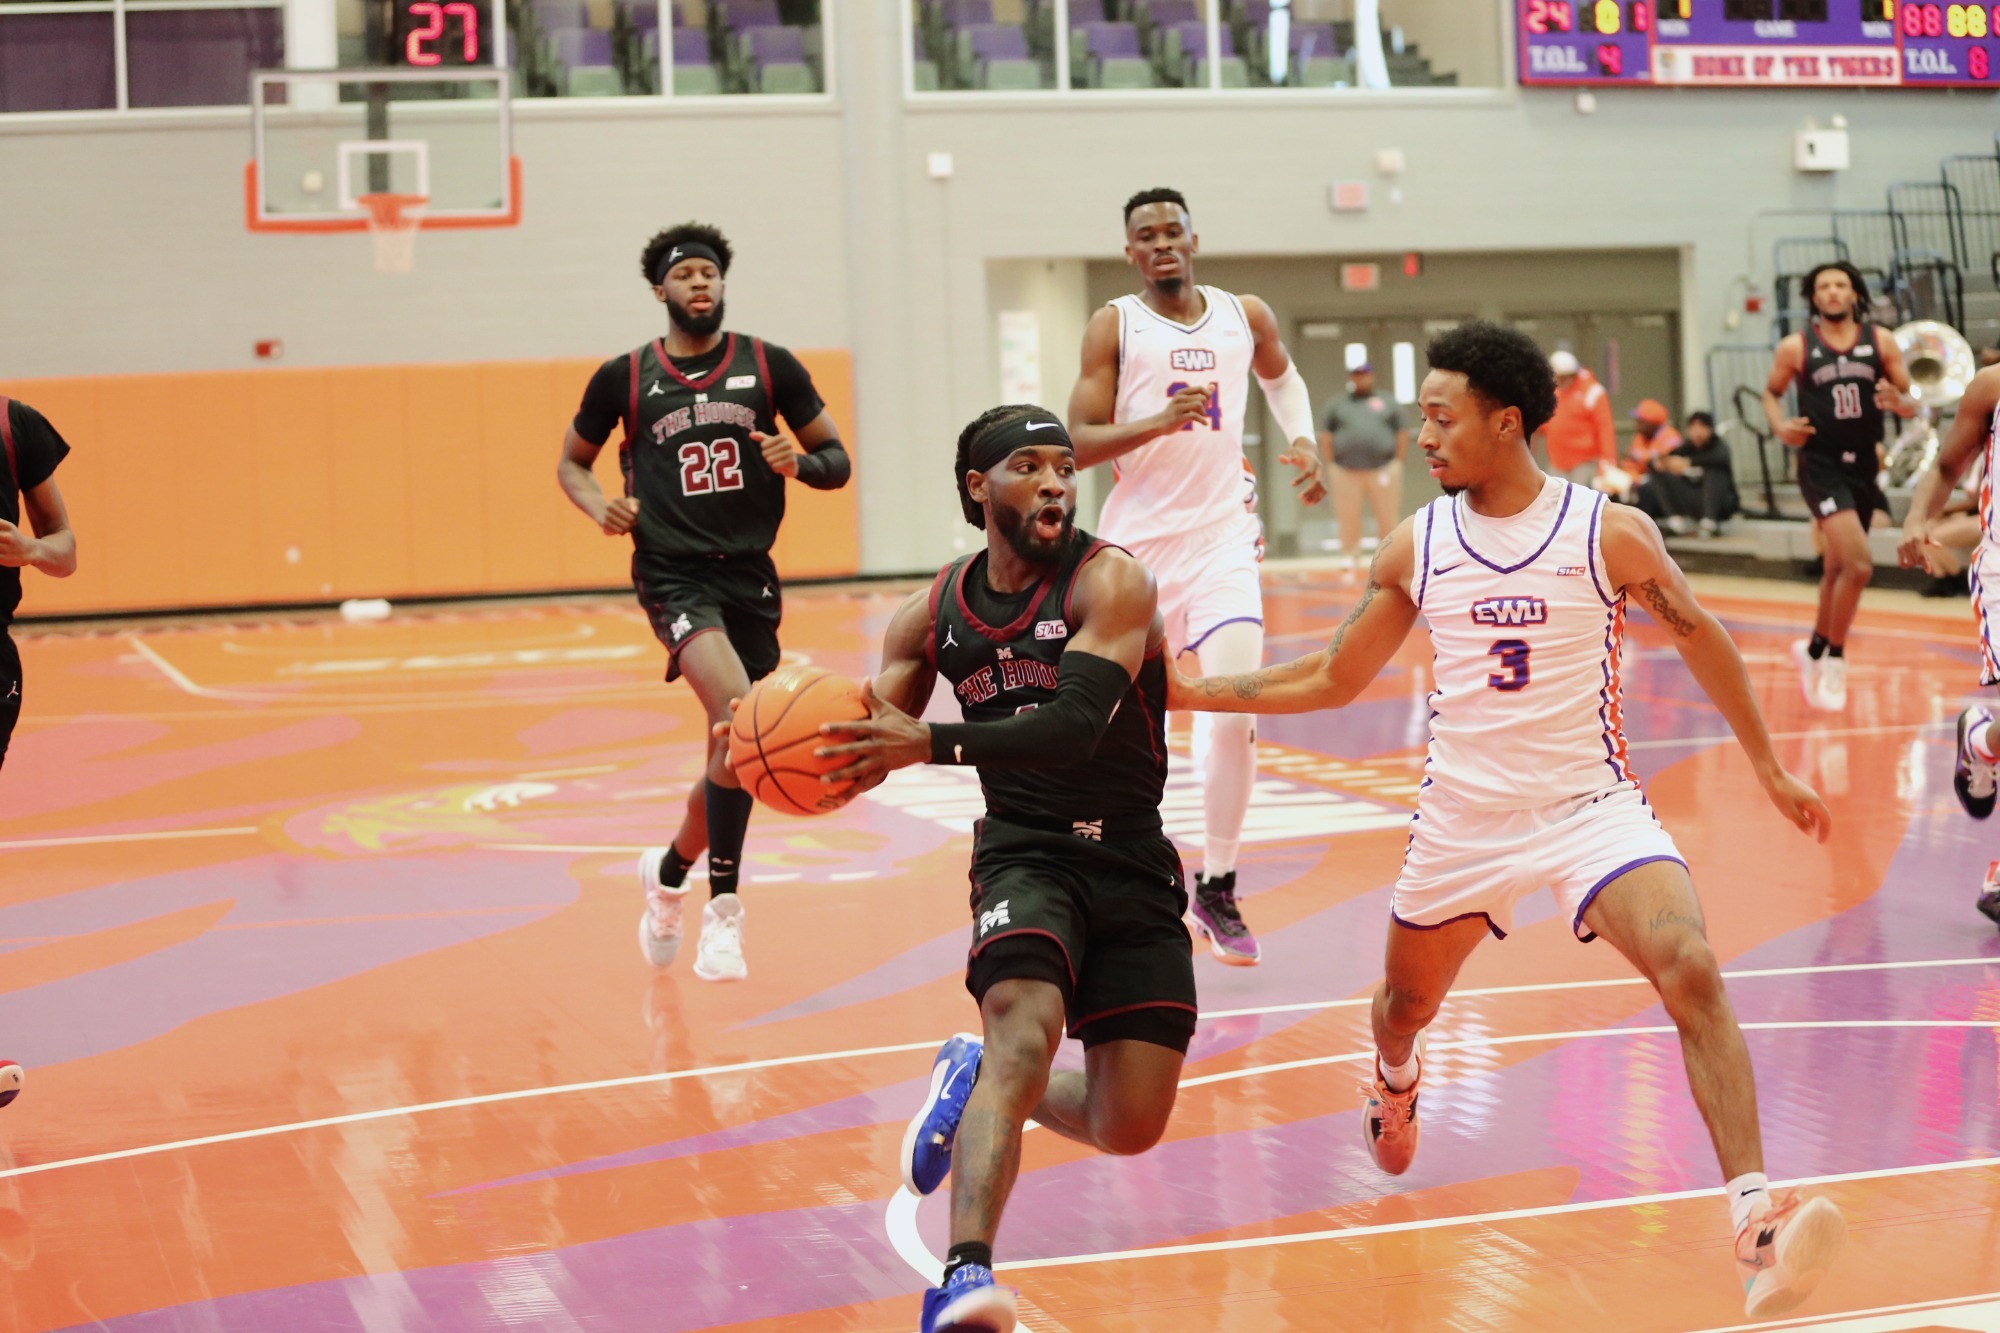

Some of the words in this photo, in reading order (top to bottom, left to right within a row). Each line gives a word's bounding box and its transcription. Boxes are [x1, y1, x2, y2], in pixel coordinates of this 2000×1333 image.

[406, 2, 478, 66] 27
[1525, 0, 1572, 34] 24
[1902, 3, 1943, 37] 88
[1946, 4, 1987, 38] 88
[1597, 44, 1622, 75] 4
[1968, 46, 1989, 79] 8
[1172, 350, 1215, 371] EWU
[1831, 382, 1863, 420] 11
[652, 406, 692, 445] THE
[693, 401, 757, 432] HOUSE
[678, 437, 744, 497] 22
[1557, 566, 1586, 577] SIAC
[1472, 598, 1545, 625] EWU
[998, 659, 1059, 691] HOU
[1487, 639, 1532, 692] 3
